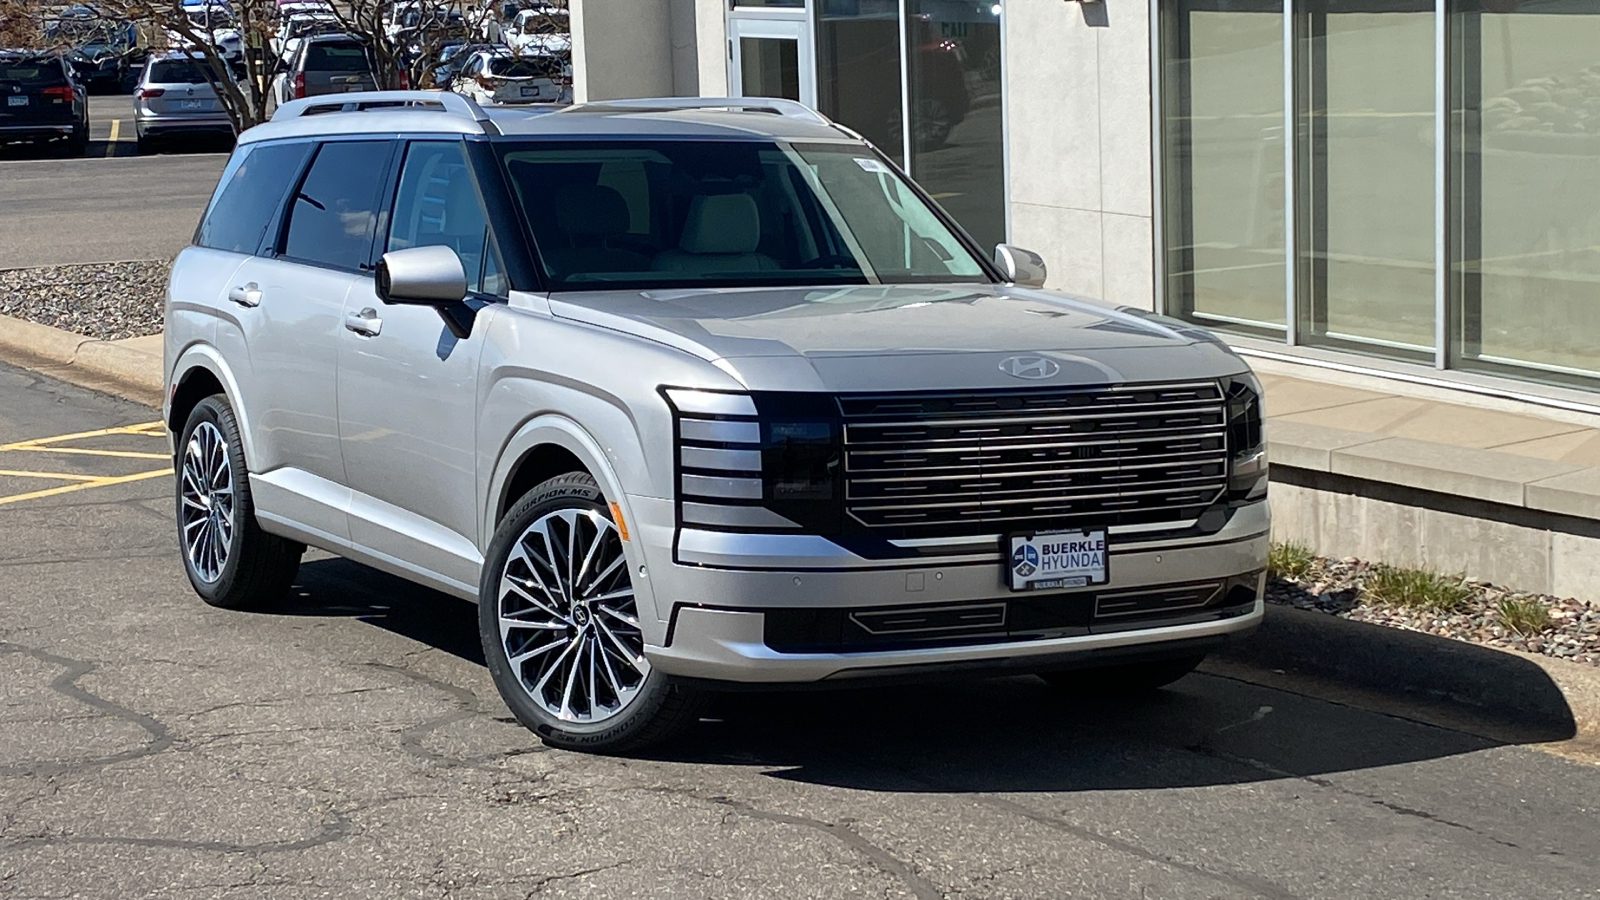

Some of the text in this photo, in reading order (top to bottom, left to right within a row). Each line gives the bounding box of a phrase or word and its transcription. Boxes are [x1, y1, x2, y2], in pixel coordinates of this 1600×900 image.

[509, 488, 592, 526] SCORPION MS
[1042, 540, 1104, 555] BUERKLE
[1042, 552, 1104, 570] HYUNDAI
